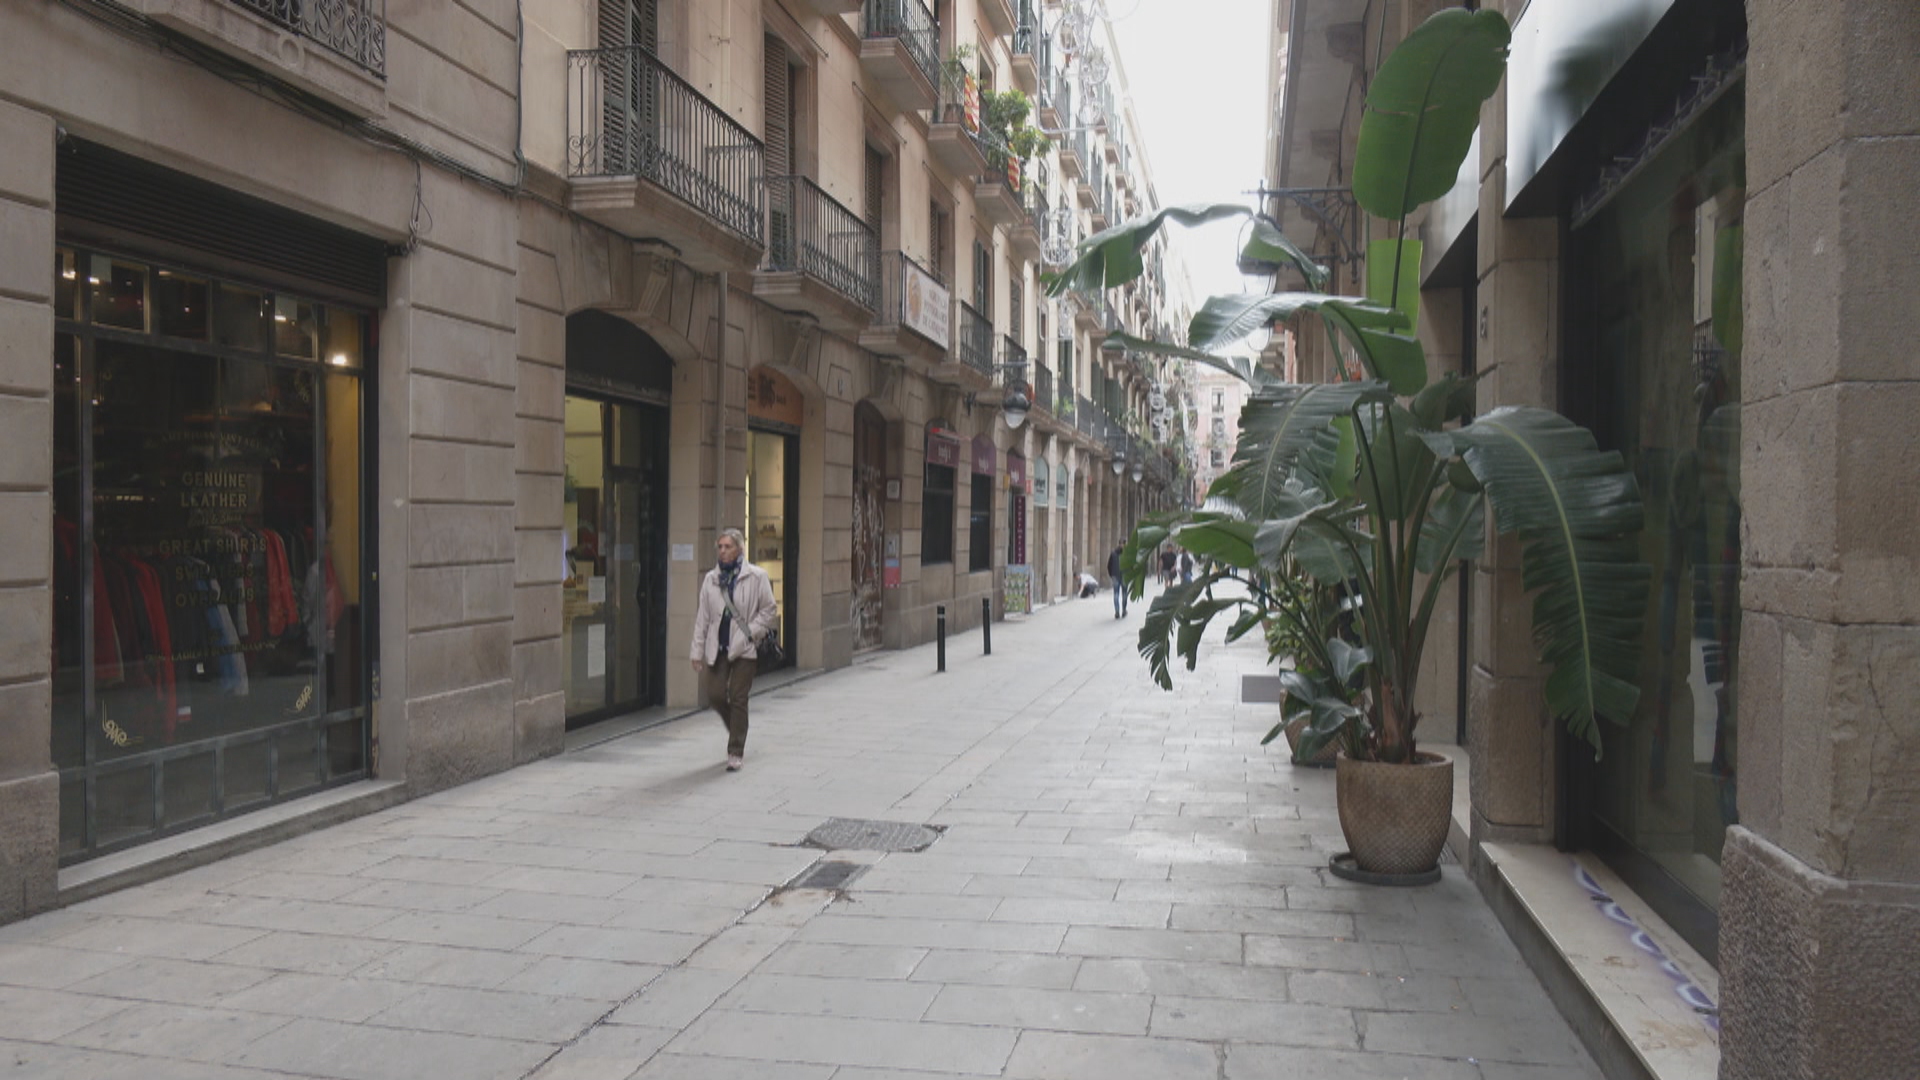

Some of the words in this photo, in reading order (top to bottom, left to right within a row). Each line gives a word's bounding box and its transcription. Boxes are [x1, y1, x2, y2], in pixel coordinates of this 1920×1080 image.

[181, 470, 247, 488] GENUINE
[180, 491, 248, 508] LEATHER
[159, 539, 210, 555] GREAT
[216, 537, 267, 553] SHIRTS
[175, 562, 254, 581] SWEATERS
